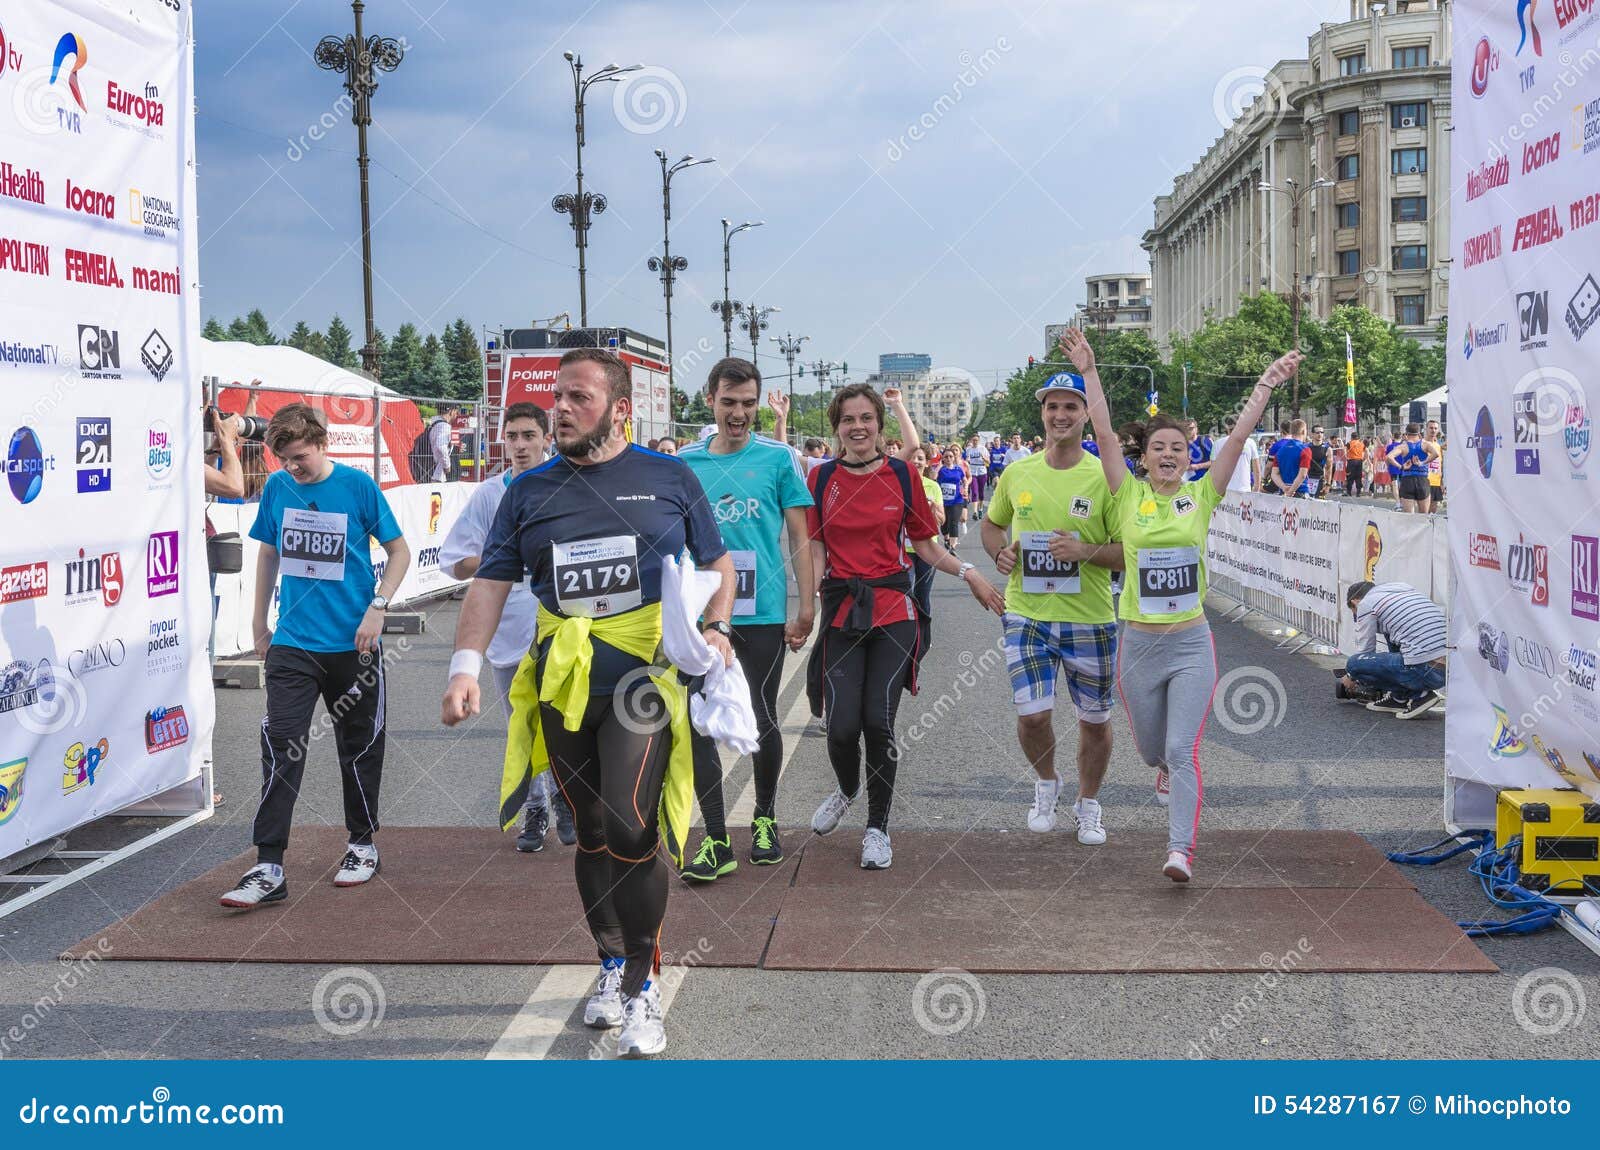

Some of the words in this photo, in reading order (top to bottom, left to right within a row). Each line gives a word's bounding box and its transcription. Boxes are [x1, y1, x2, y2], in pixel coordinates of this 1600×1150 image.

[145, 81, 158, 98] fm
[107, 80, 163, 127] Europa
[57, 107, 81, 134] TVR
[1522, 132, 1560, 175] Ioana
[0, 161, 45, 205] Health
[66, 179, 115, 219] Ioana
[143, 196, 174, 215] NATIONAL
[143, 212, 180, 232] GEOGRAPHIC
[132, 266, 181, 295] mami
[80, 424, 107, 435] DIGI
[149, 430, 167, 448] Itsy
[1564, 427, 1589, 451] Bitsy
[80, 440, 108, 477] 24
[148, 448, 171, 469] Bitsy
[89, 475, 99, 486] HD
[283, 530, 343, 555] CP1887
[149, 536, 178, 579] RL
[65, 548, 122, 606] ring
[563, 564, 631, 592] 2179
[1146, 567, 1190, 590] CP811
[149, 618, 177, 637] inyour
[148, 633, 179, 656] pocket
[147, 655, 182, 668] ESSENTIAL
